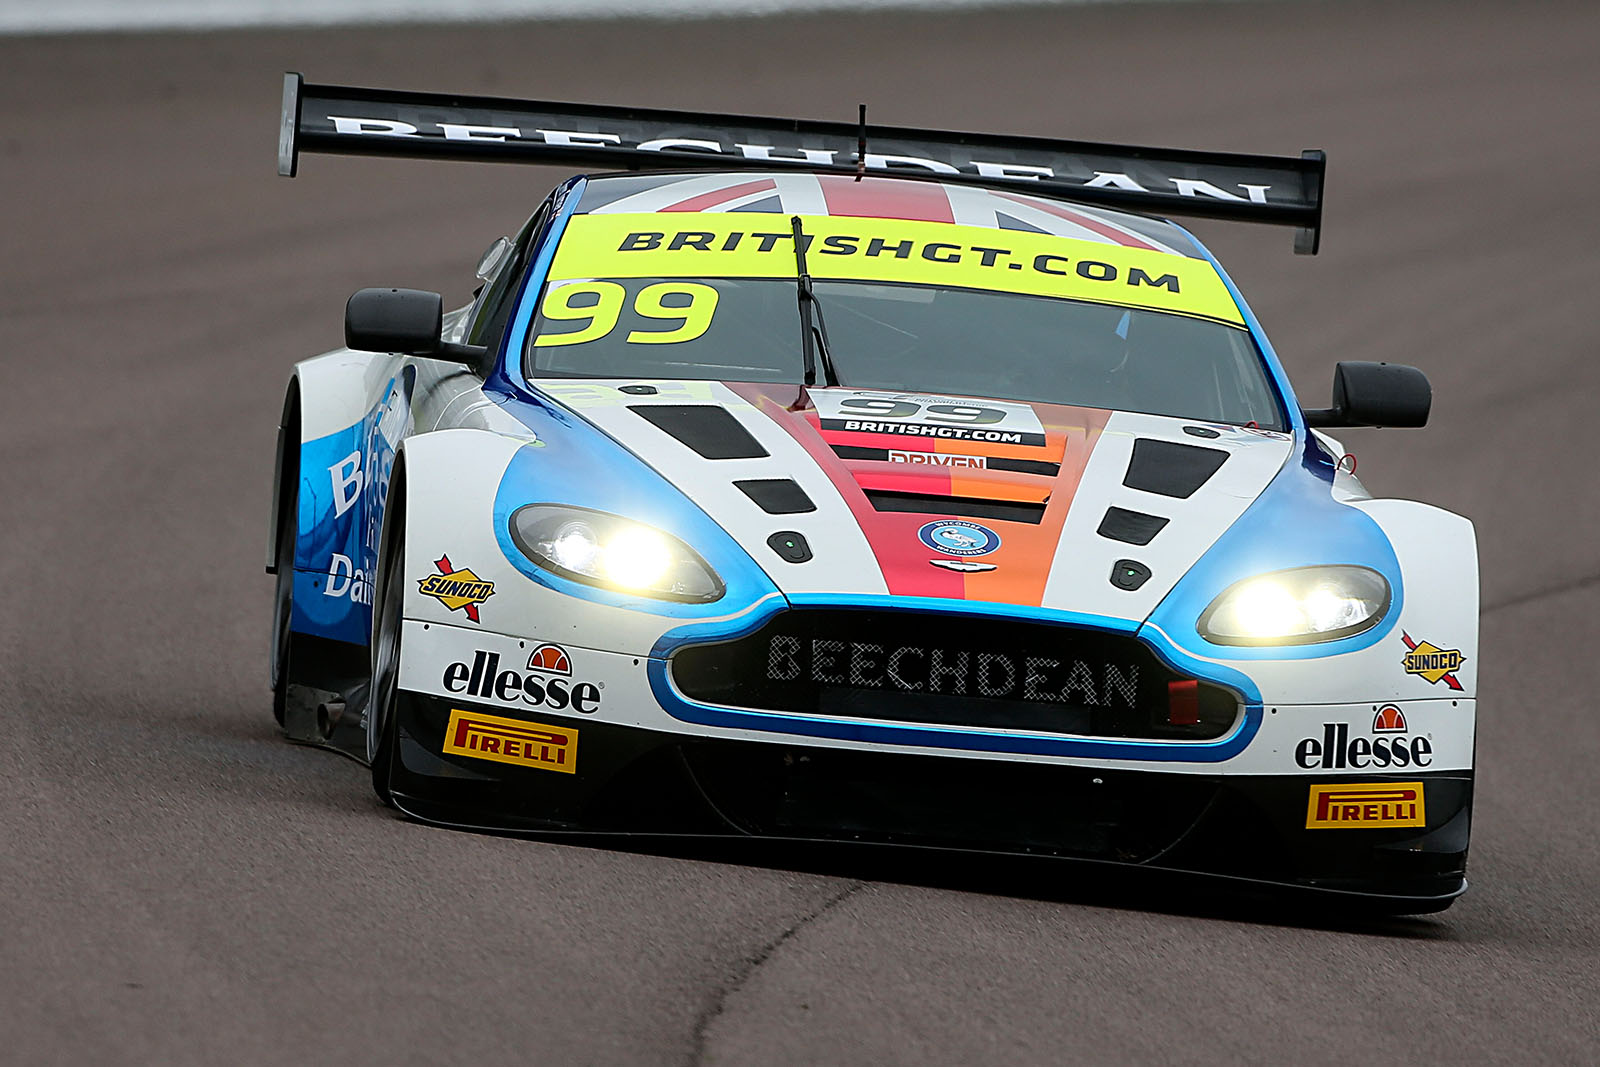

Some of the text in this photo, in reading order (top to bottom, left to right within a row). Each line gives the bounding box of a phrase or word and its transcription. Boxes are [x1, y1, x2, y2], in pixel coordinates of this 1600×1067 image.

[618, 231, 1182, 294] BRITISHGT.COM
[534, 281, 720, 346] 99
[838, 398, 1007, 424] 99
[844, 420, 1022, 443] BRITISHGT.COM
[891, 453, 984, 469] DRIVEN
[422, 577, 492, 600] SUNOCO
[766, 634, 1140, 708] BEECHDEAN
[1406, 652, 1458, 670] SUNOCO
[443, 650, 601, 714] ellesse
[453, 718, 569, 765] PIRELLI
[1295, 723, 1432, 769] ellesse
[1316, 790, 1417, 821] PIRELLI
